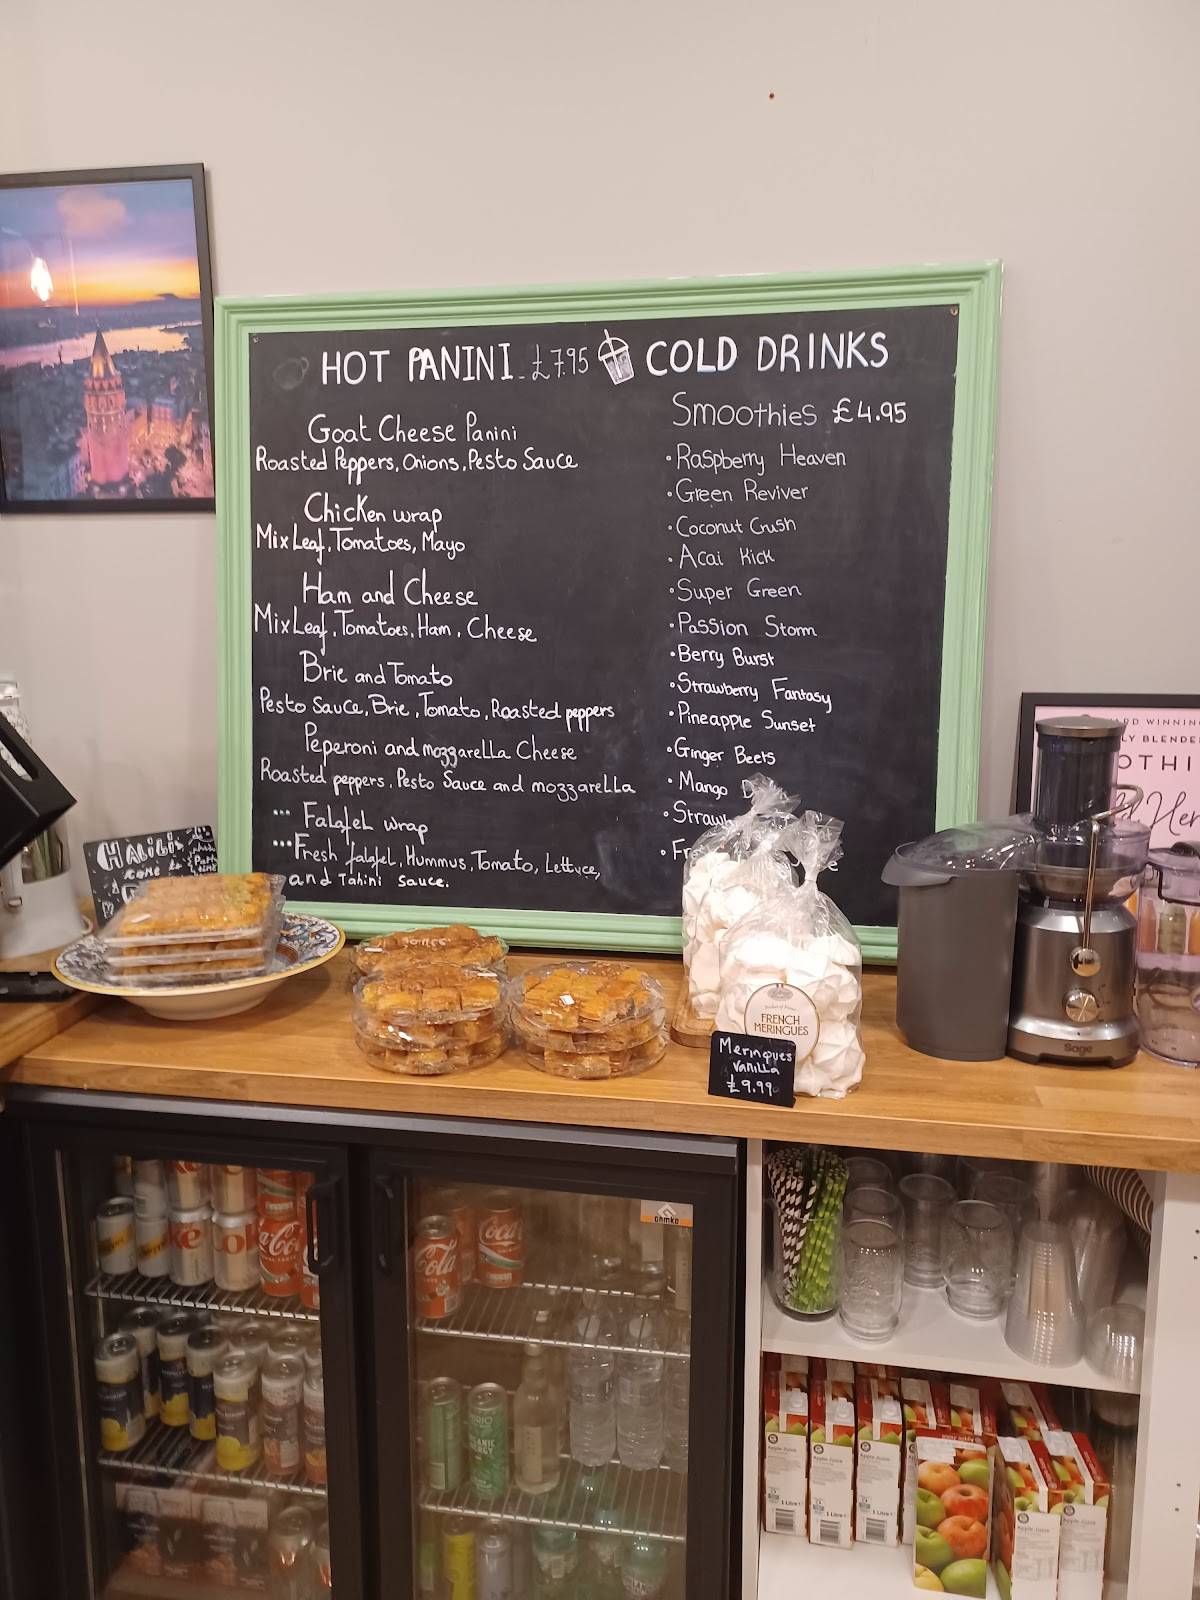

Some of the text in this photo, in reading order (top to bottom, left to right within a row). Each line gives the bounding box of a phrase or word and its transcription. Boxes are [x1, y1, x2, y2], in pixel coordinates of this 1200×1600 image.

[321, 350, 390, 385] HOT
[408, 343, 514, 382] PANINI
[646, 331, 890, 376] COLD DRINKS
[672, 391, 907, 427] Smoothies £4.95
[308, 411, 518, 443] Goat Cheese Panini
[255, 446, 327, 472] Roasted
[334, 448, 400, 485] Peppers,
[523, 446, 579, 470] Sauce
[677, 443, 847, 476] Raspberry Heaven
[676, 478, 809, 503] Green Reviver
[303, 492, 443, 533] Chicken wrap
[676, 515, 797, 537] Coconut Crush
[422, 530, 466, 560] Mayo
[680, 543, 775, 569] Acai Kick
[302, 568, 479, 606] Ham and Cheese
[677, 577, 802, 605] Super Green
[467, 616, 537, 643] Cheese
[677, 612, 749, 636] Passion
[300, 650, 453, 687] Brie and Tomato
[677, 644, 775, 668] Berry Burst
[677, 672, 832, 714] Strawberry Fantasy
[259, 687, 306, 714] Pesto
[312, 697, 368, 717] Sauce,
[492, 698, 562, 720] Roasted
[566, 703, 615, 732] peppers
[678, 701, 816, 733] Pineapple Sunset
[1146, 718, 1200, 726] WINNIN
[304, 722, 577, 767] Peperoni and mozzarella Cheese
[674, 737, 776, 767] Ginger Beets
[1142, 735, 1200, 743] BLENDE
[260, 757, 327, 784] Roasted
[397, 768, 435, 790] Pesto
[442, 769, 487, 791] Sauce
[492, 774, 524, 793] and
[531, 774, 636, 802] mozzarella
[679, 770, 728, 800] Mango
[302, 802, 428, 845] Falafel wrap
[294, 832, 338, 862] Fresh
[289, 867, 332, 887] and
[338, 872, 382, 888] Tahini
[754, 1022, 809, 1036] MERINGUES
[761, 1013, 800, 1026] FRENCH
[1064, 1043, 1094, 1057] Sage
